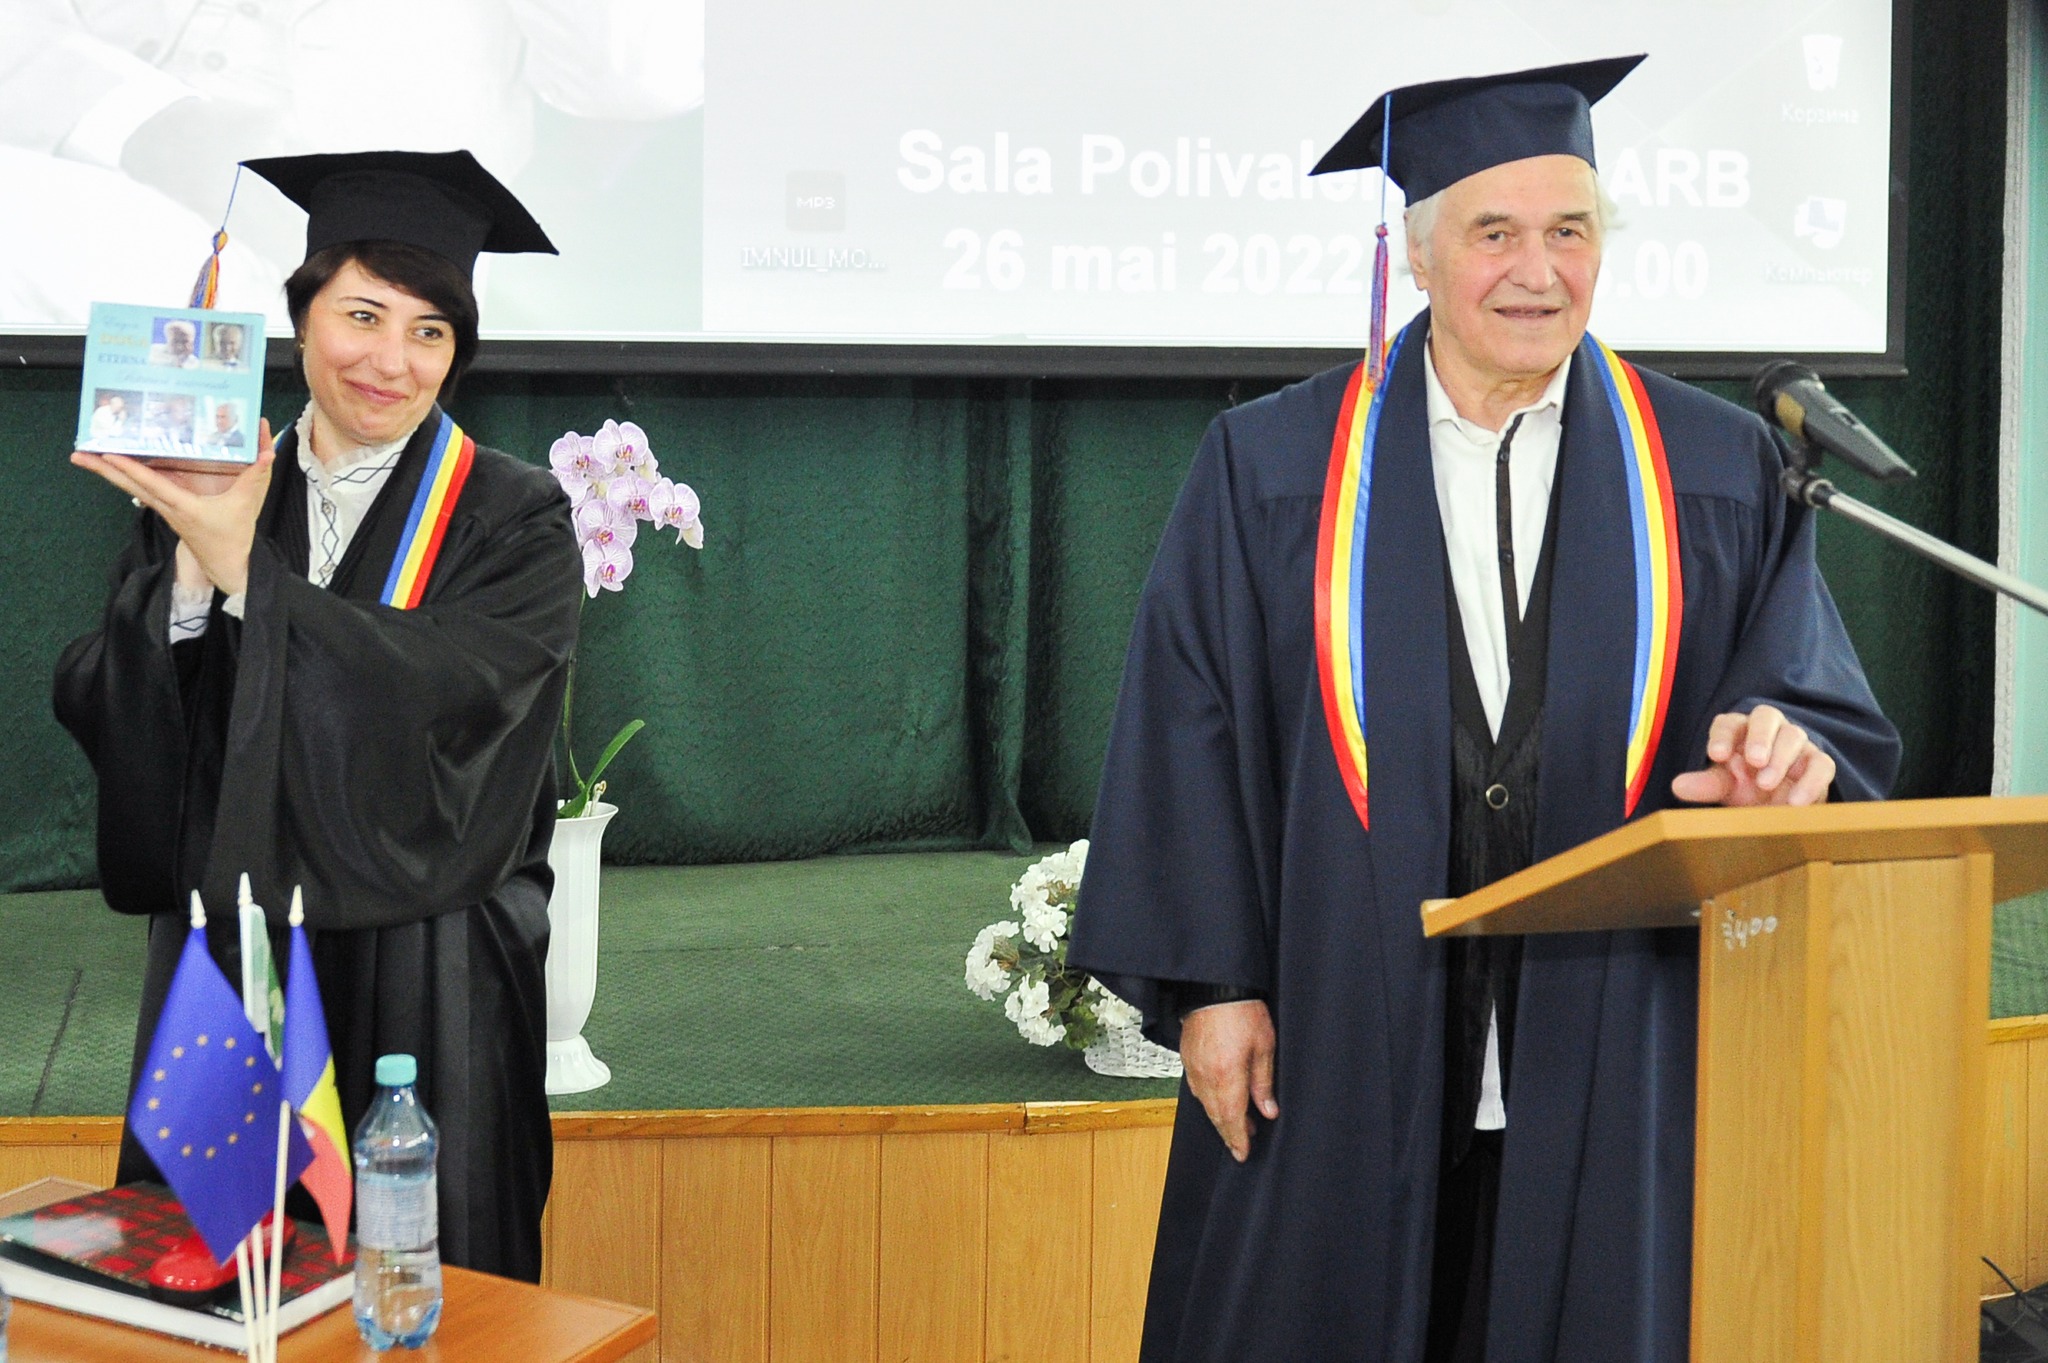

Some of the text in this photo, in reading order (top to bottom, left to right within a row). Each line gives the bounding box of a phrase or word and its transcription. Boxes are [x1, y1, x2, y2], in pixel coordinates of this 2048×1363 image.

[1781, 103, 1859, 127] Корзина
[896, 129, 1053, 194] Sala
[795, 196, 836, 210] MP3
[942, 229, 1025, 293] 26
[1051, 232, 1176, 293] mai
[1201, 233, 1364, 295] 2022
